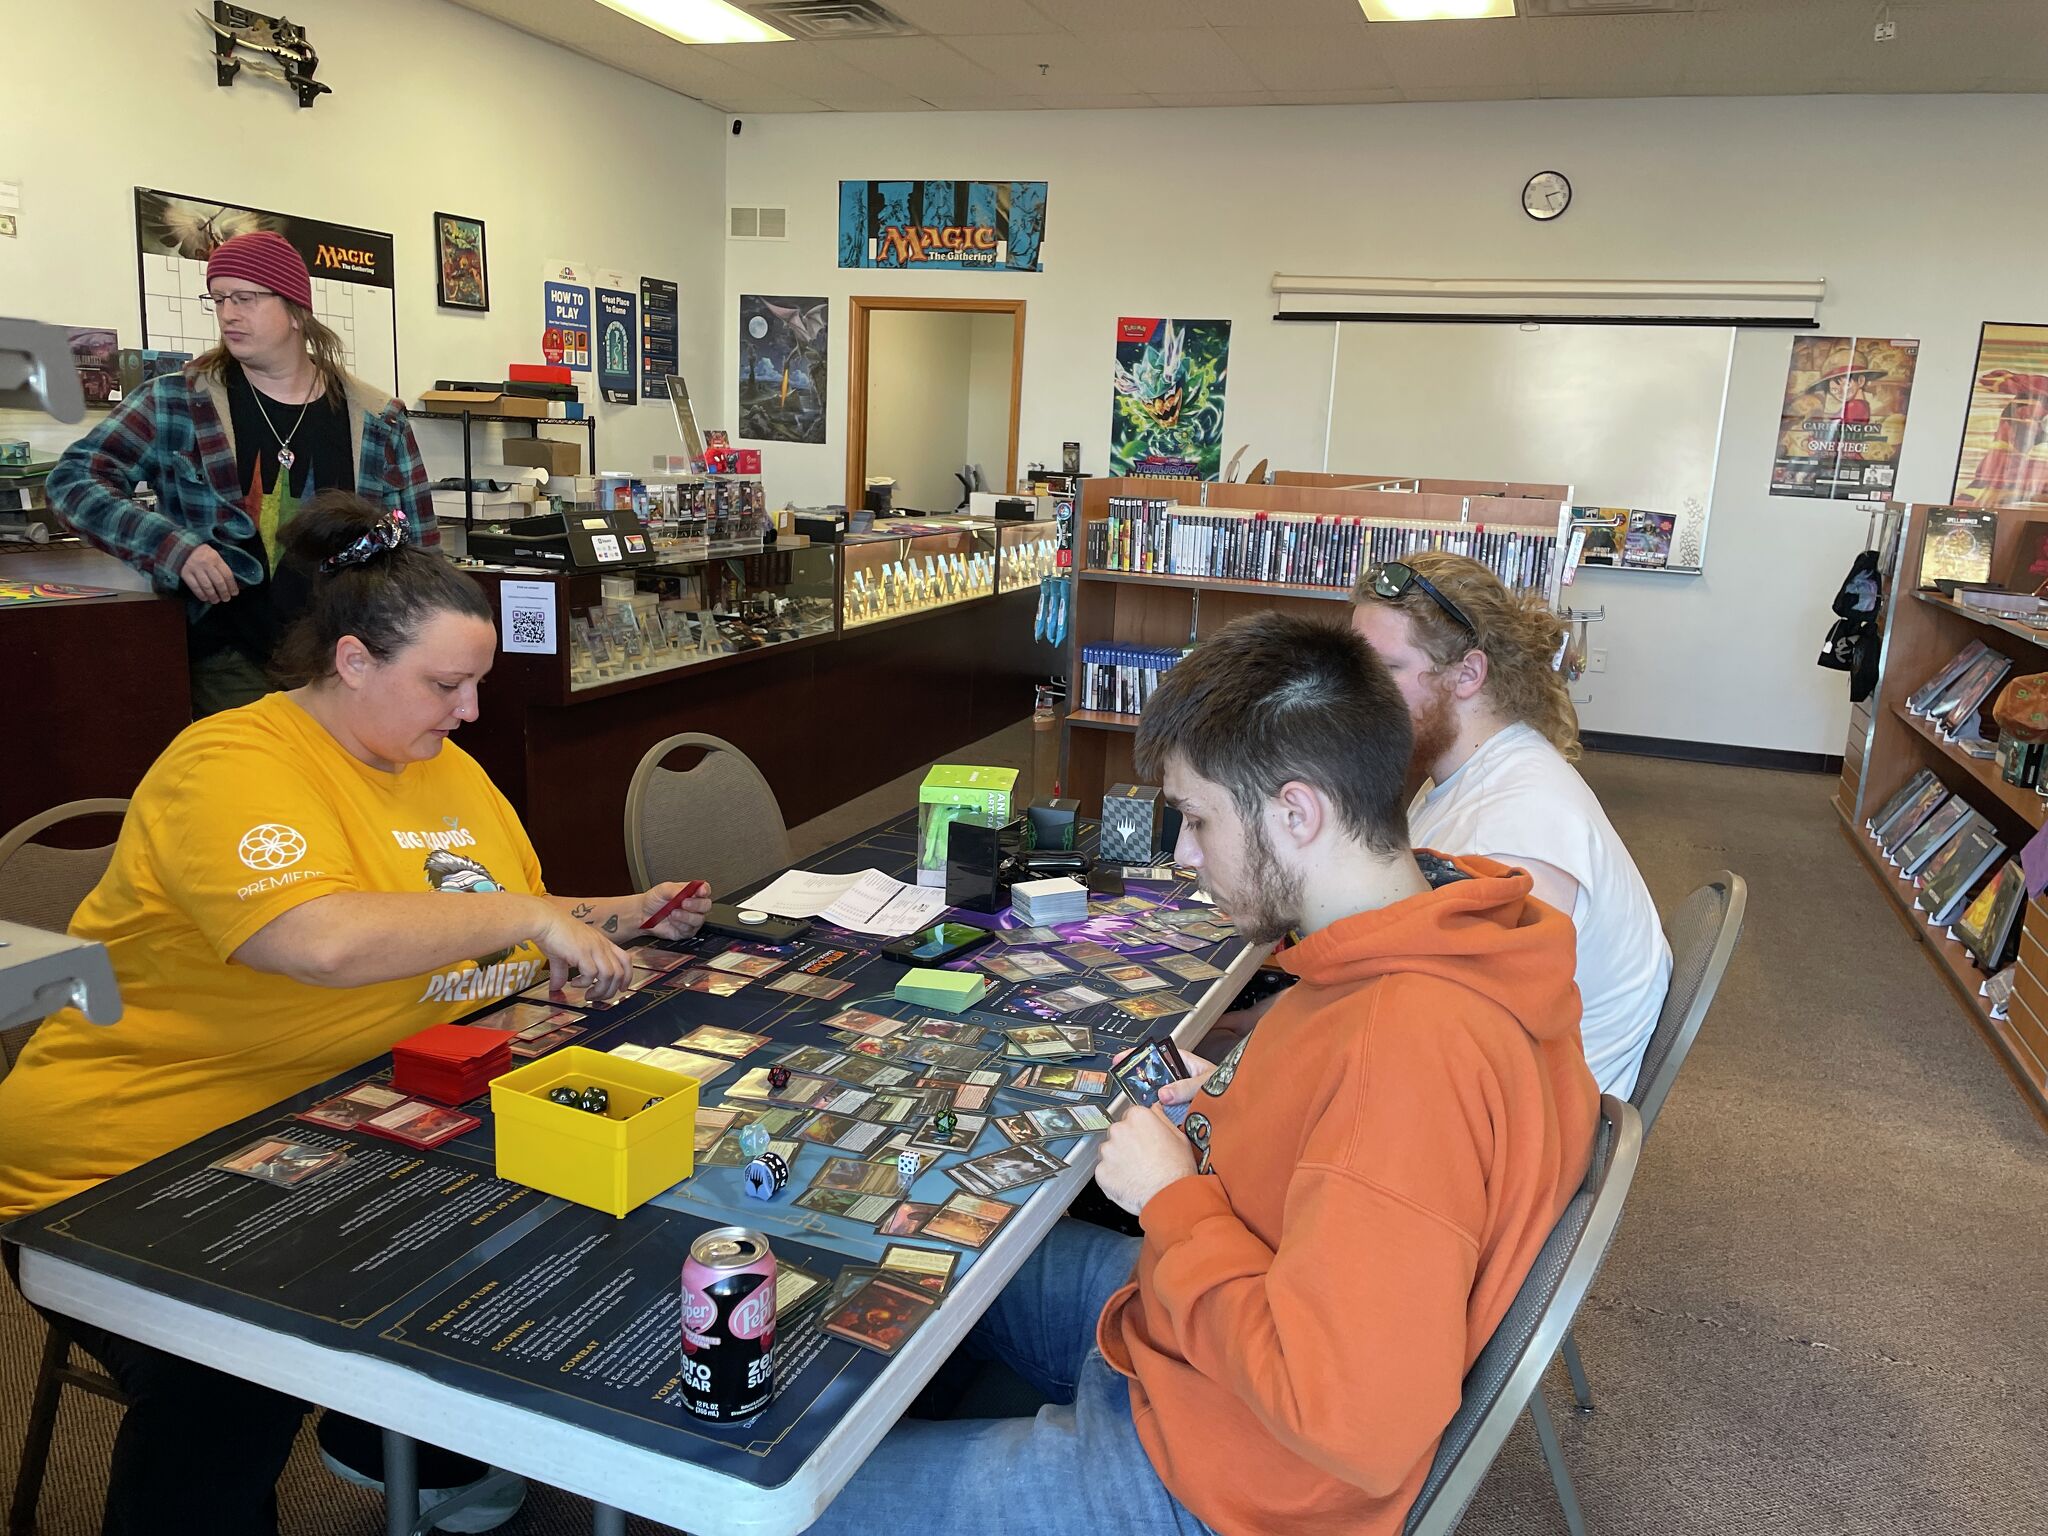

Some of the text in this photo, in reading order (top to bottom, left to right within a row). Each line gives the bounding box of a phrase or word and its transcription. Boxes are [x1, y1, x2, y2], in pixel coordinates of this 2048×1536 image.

[876, 224, 998, 264] MAGIC
[314, 244, 376, 269] MAGIC
[928, 251, 993, 263] The Gathering
[351, 264, 375, 275] Gathering
[550, 289, 584, 306] HOW TO
[601, 294, 630, 307] Great Place
[556, 305, 579, 320] PLAY
[605, 305, 627, 315] to Game
[1136, 462, 1195, 476] TWILIGHT
[391, 827, 477, 851] BIG RAPIDS
[383, 1159, 428, 1180] COMBAT
[437, 1172, 481, 1194] SCORING
[503, 1189, 530, 1203] TART
[467, 1209, 498, 1226] TURN
[424, 1280, 501, 1331] START OF TURN
[554, 1314, 575, 1328] point
[488, 1319, 537, 1352] SCORING
[515, 1331, 542, 1348] points
[552, 1337, 574, 1352] score
[568, 1324, 589, 1338] them
[576, 1349, 607, 1371] Resolve
[599, 1332, 627, 1351] defend
[632, 1308, 654, 1324] attack
[784, 1334, 808, 1353] combat
[556, 1339, 602, 1372] COMBAT
[587, 1352, 619, 1375] Starting
[611, 1341, 630, 1354] with
[619, 1368, 643, 1384] Units
[645, 1347, 665, 1361] from
[748, 1352, 774, 1377] zer
[797, 1348, 822, 1369] combat
[609, 1366, 631, 1381] Each
[624, 1355, 642, 1367] side
[645, 1360, 666, 1375] score
[682, 1354, 711, 1381] ero
[649, 1377, 682, 1401] YOUR
[682, 1370, 711, 1393] UGAR
[702, 1402, 709, 1410] FL
[710, 1403, 719, 1411] OZ
